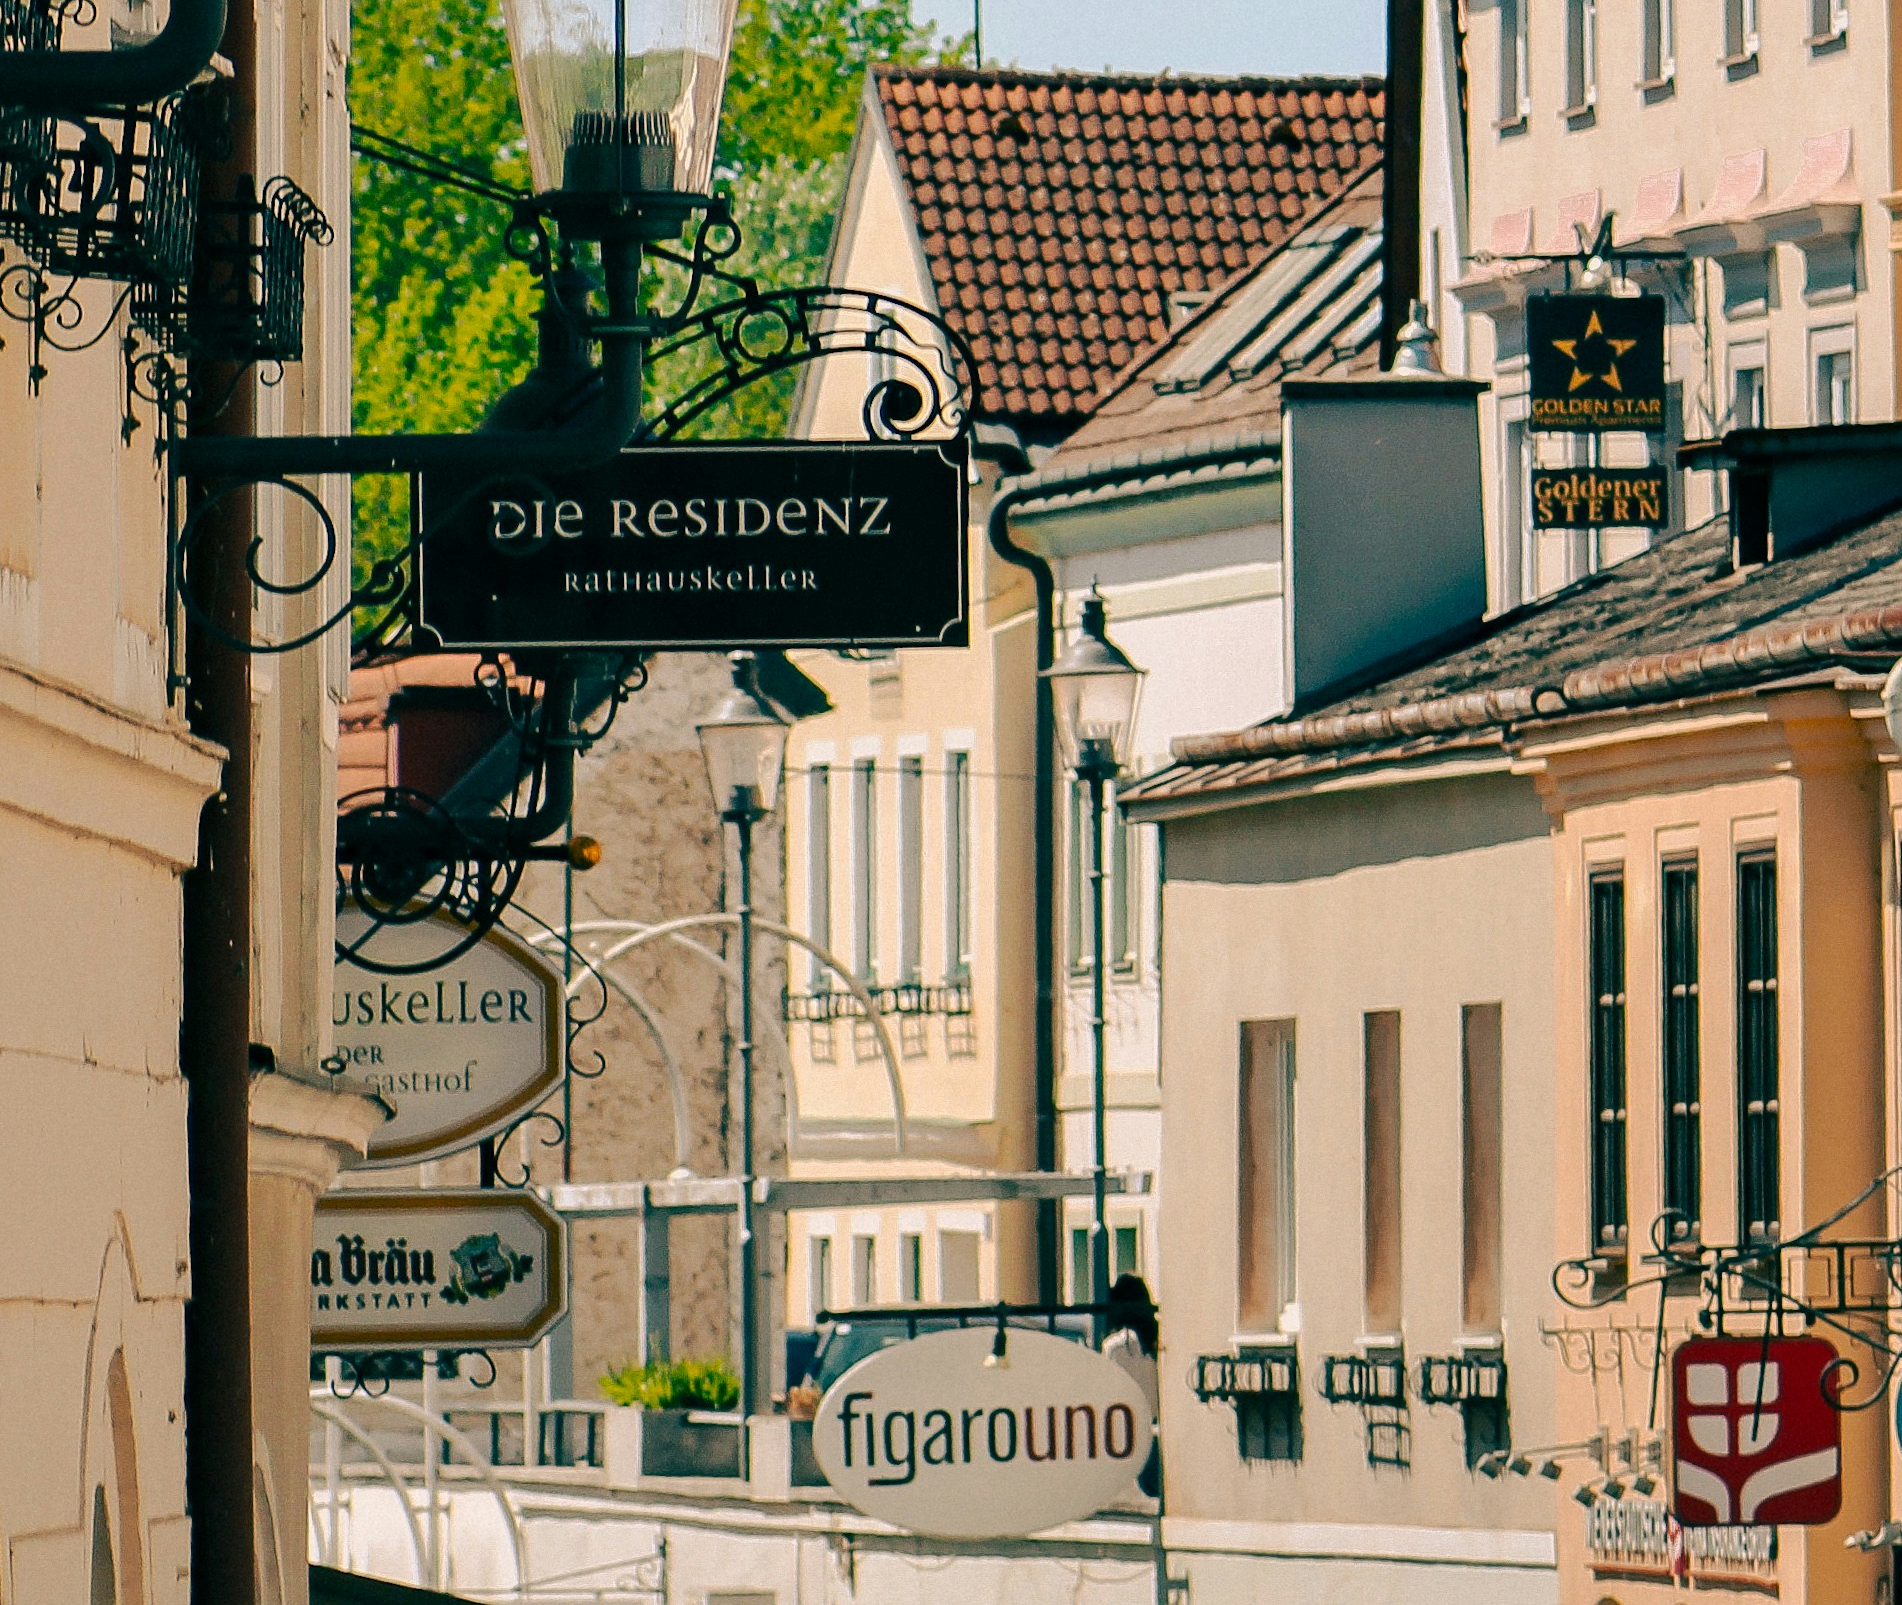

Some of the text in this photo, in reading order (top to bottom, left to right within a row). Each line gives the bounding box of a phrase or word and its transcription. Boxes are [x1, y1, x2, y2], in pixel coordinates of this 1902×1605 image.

[1532, 398, 1660, 415] GOLDEN STAR
[1534, 474, 1661, 500] Goldener
[1537, 498, 1660, 522] STERN
[336, 1233, 437, 1286] Bräu
[837, 1391, 1137, 1487] figarouno
